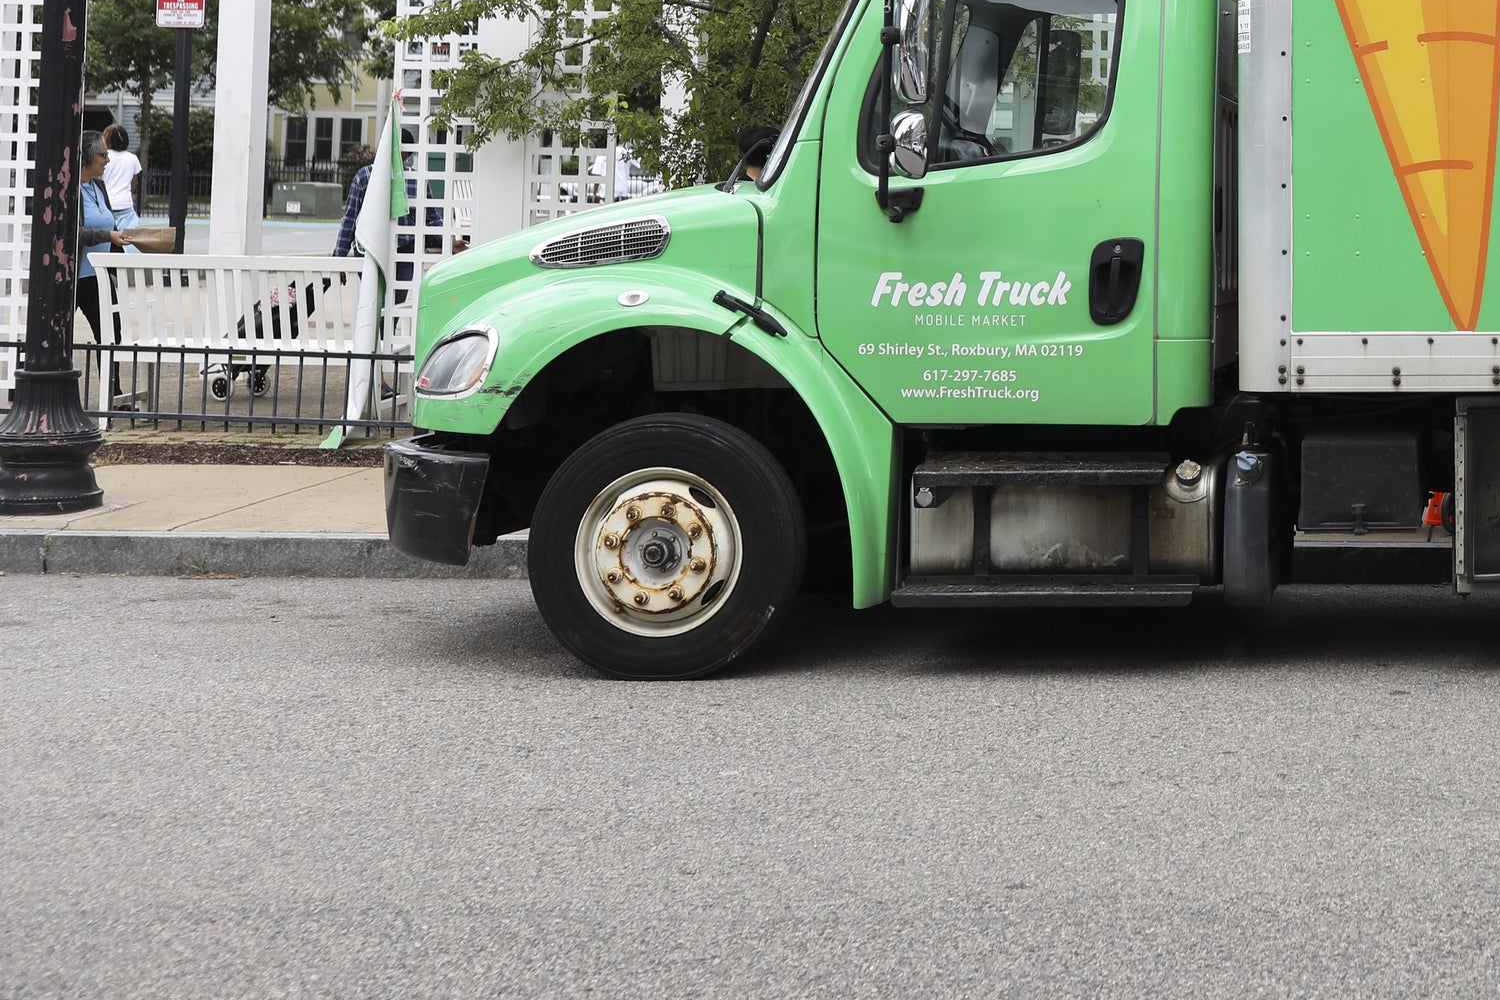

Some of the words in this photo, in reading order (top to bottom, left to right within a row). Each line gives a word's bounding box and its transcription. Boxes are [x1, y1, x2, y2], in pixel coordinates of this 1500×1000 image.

[870, 271, 967, 308] Fresh
[976, 271, 1072, 307] Truck
[914, 314, 965, 327] MOBILE
[971, 314, 1026, 327] MARKET
[857, 343, 875, 356] 69
[878, 342, 925, 359] Shirley
[927, 343, 949, 358] St.,
[951, 343, 1012, 359] Roxbury,
[1014, 344, 1037, 356] MA
[1040, 344, 1084, 357] 02119
[922, 369, 1017, 383] 617-297-7685
[900, 386, 1040, 402] www.FreshTruck.org
